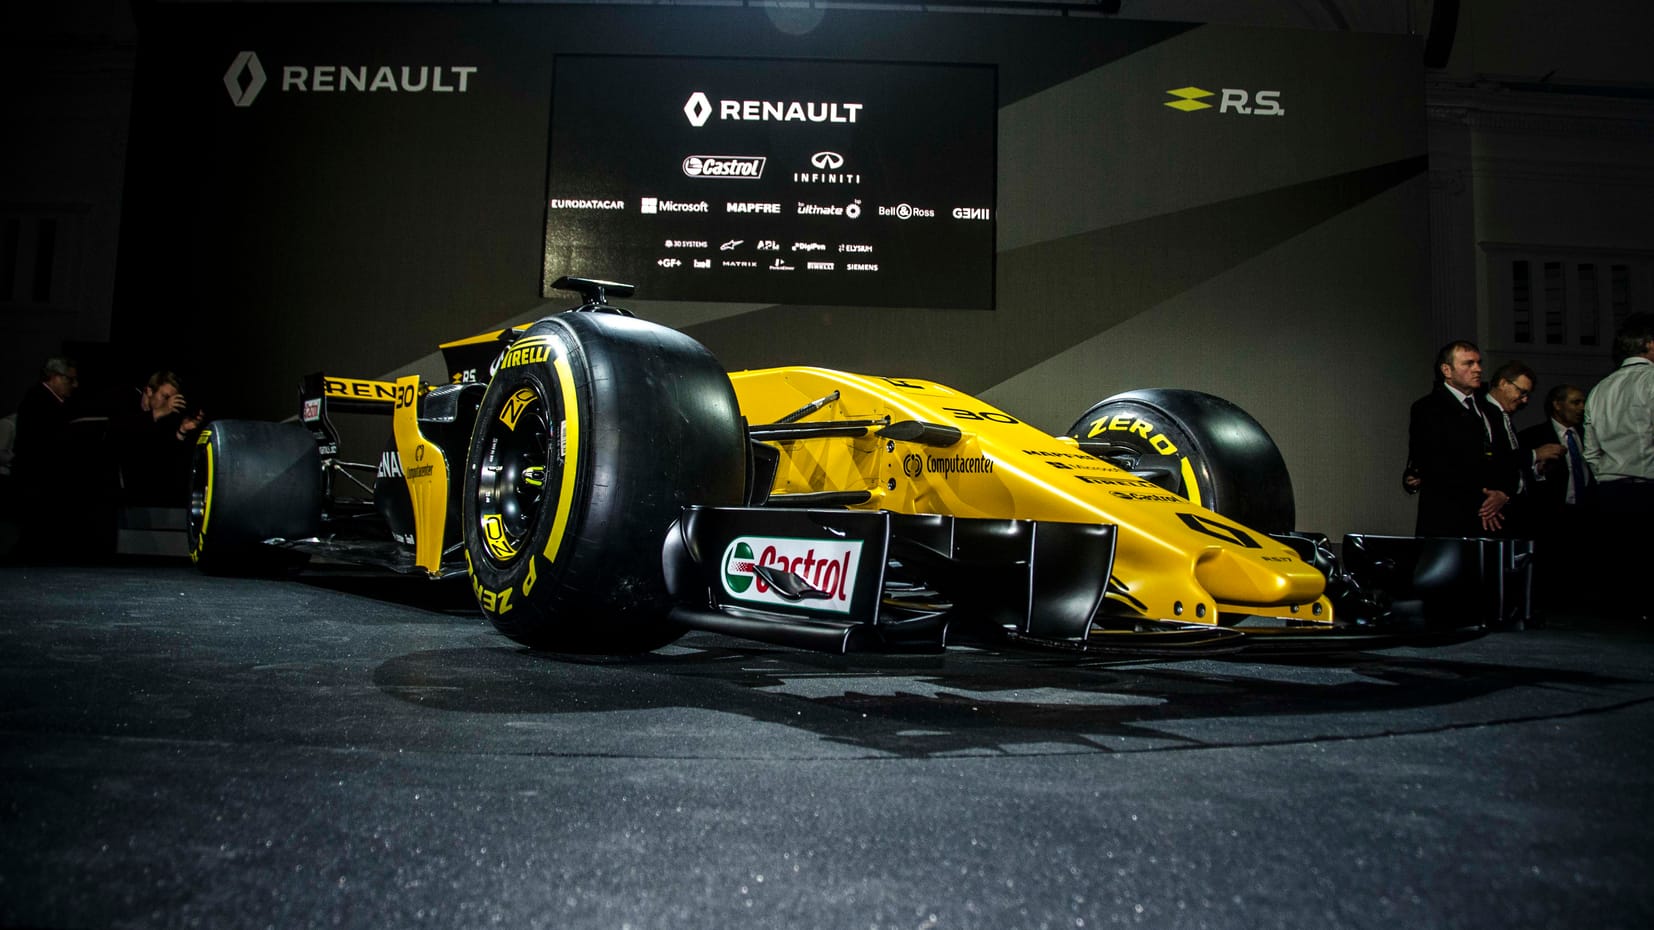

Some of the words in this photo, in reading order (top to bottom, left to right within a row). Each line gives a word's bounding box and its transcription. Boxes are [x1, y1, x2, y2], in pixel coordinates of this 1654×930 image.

[282, 66, 477, 92] RENAULT
[720, 100, 863, 123] RENAULT
[702, 159, 760, 176] Castrol
[794, 173, 860, 184] INFINITI
[551, 199, 625, 210] EURODATACAR
[659, 201, 709, 213] Microsoft
[726, 202, 781, 214] MAPFRE
[797, 205, 844, 216] ultimate
[878, 206, 896, 216] Bell
[913, 207, 935, 217] Ross
[846, 263, 879, 272] SIEMENS
[325, 380, 397, 400] REN
[396, 384, 415, 409] 30
[942, 407, 1019, 424] 30
[1087, 414, 1178, 456] ZERO
[926, 454, 994, 480] Computacenter
